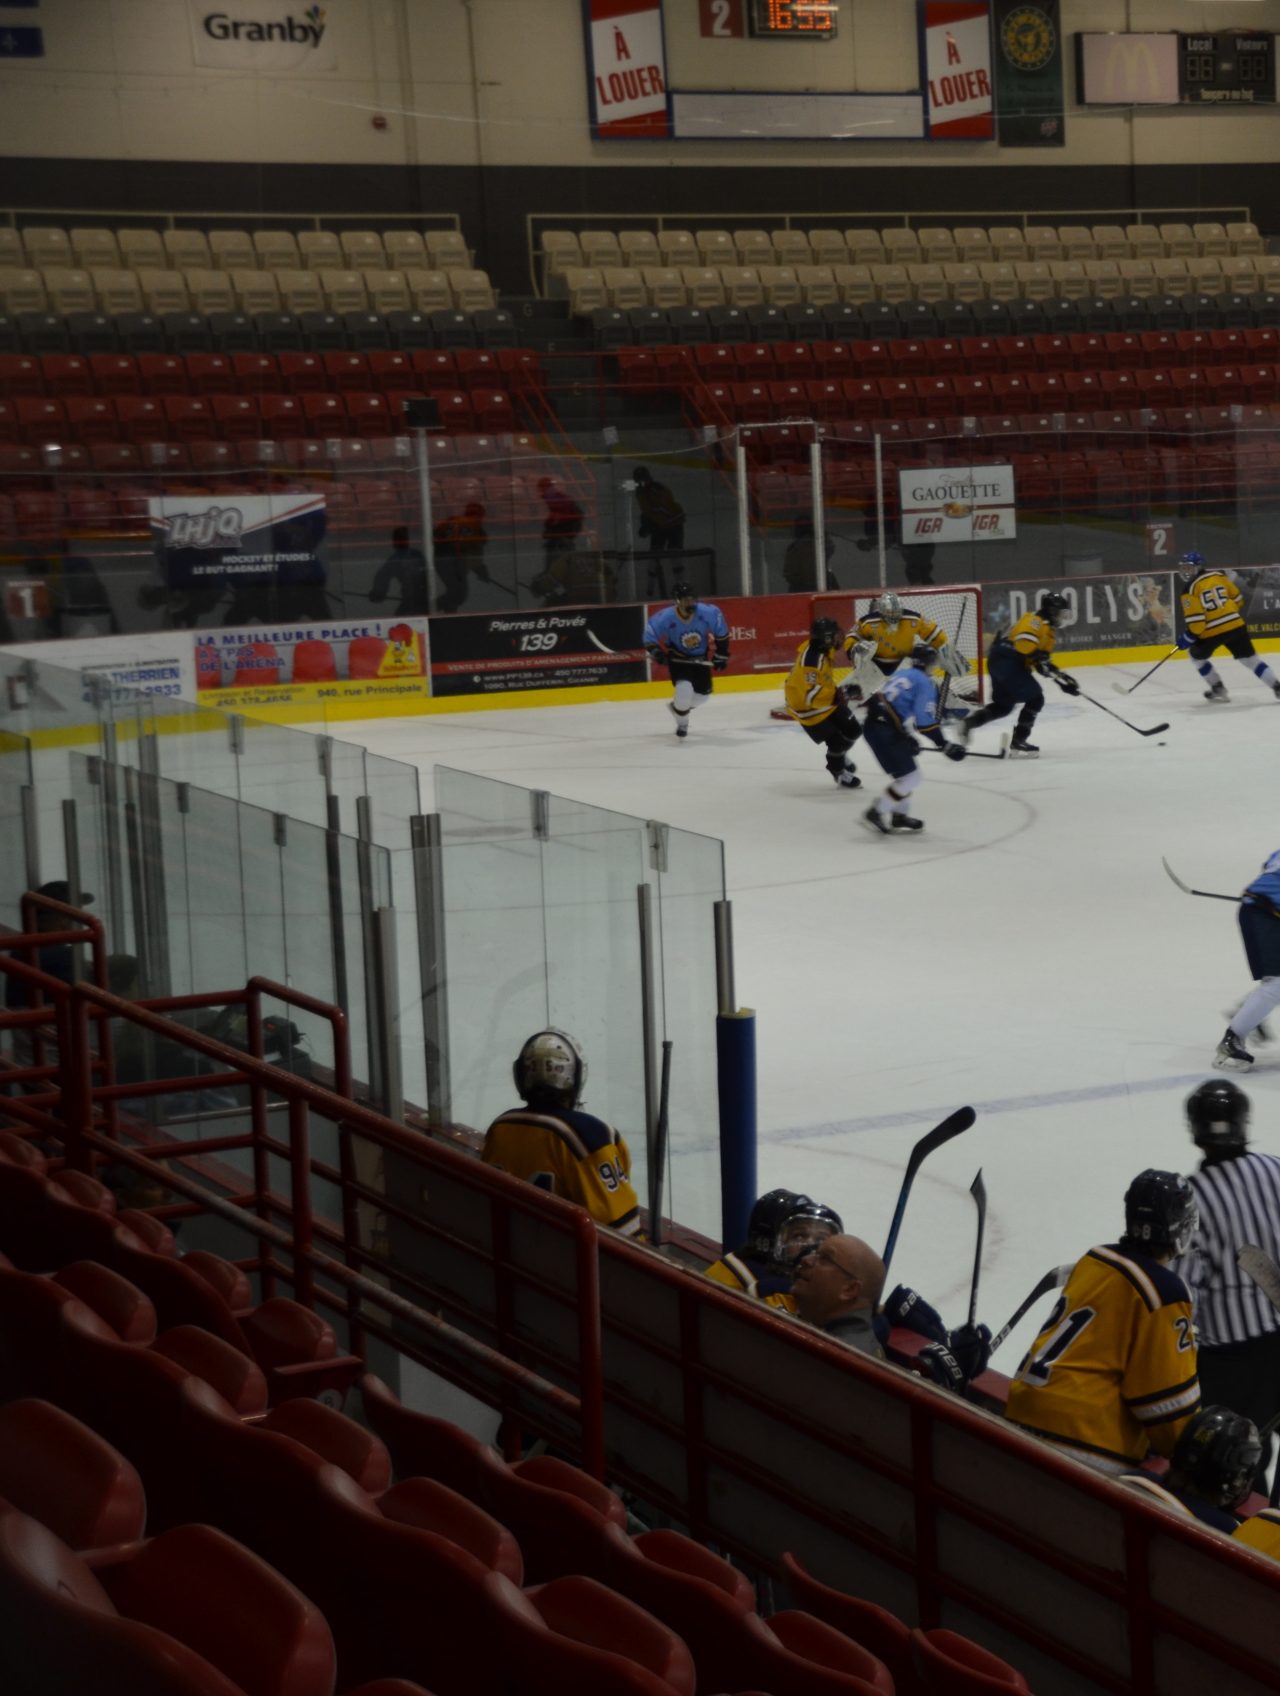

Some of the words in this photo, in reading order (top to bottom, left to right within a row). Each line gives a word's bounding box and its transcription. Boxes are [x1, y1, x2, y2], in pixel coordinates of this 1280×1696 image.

[710, 0, 731, 36] 2
[204, 13, 325, 48] Granby
[613, 25, 631, 61] À
[945, 31, 961, 66] À
[596, 65, 665, 105] LOUER
[929, 69, 992, 107] LOUER
[912, 484, 1001, 502] GAOUETTE
[915, 518, 944, 534] IGA
[972, 514, 1000, 531] IGA
[1153, 529, 1168, 556] 2
[19, 587, 35, 618] 1
[489, 620, 535, 632] Pierres
[536, 618, 547, 629] &
[549, 616, 587, 629] Pavés
[198, 636, 214, 646] LA
[222, 631, 318, 645] MEILLEURE
[321, 627, 370, 639] PLACE
[520, 633, 558, 652] 139
[111, 667, 180, 684] THERRIEN
[200, 662, 218, 671] DE
[448, 662, 474, 671] VENTE
[344, 687, 362, 696] rue
[366, 684, 423, 697] Principale
